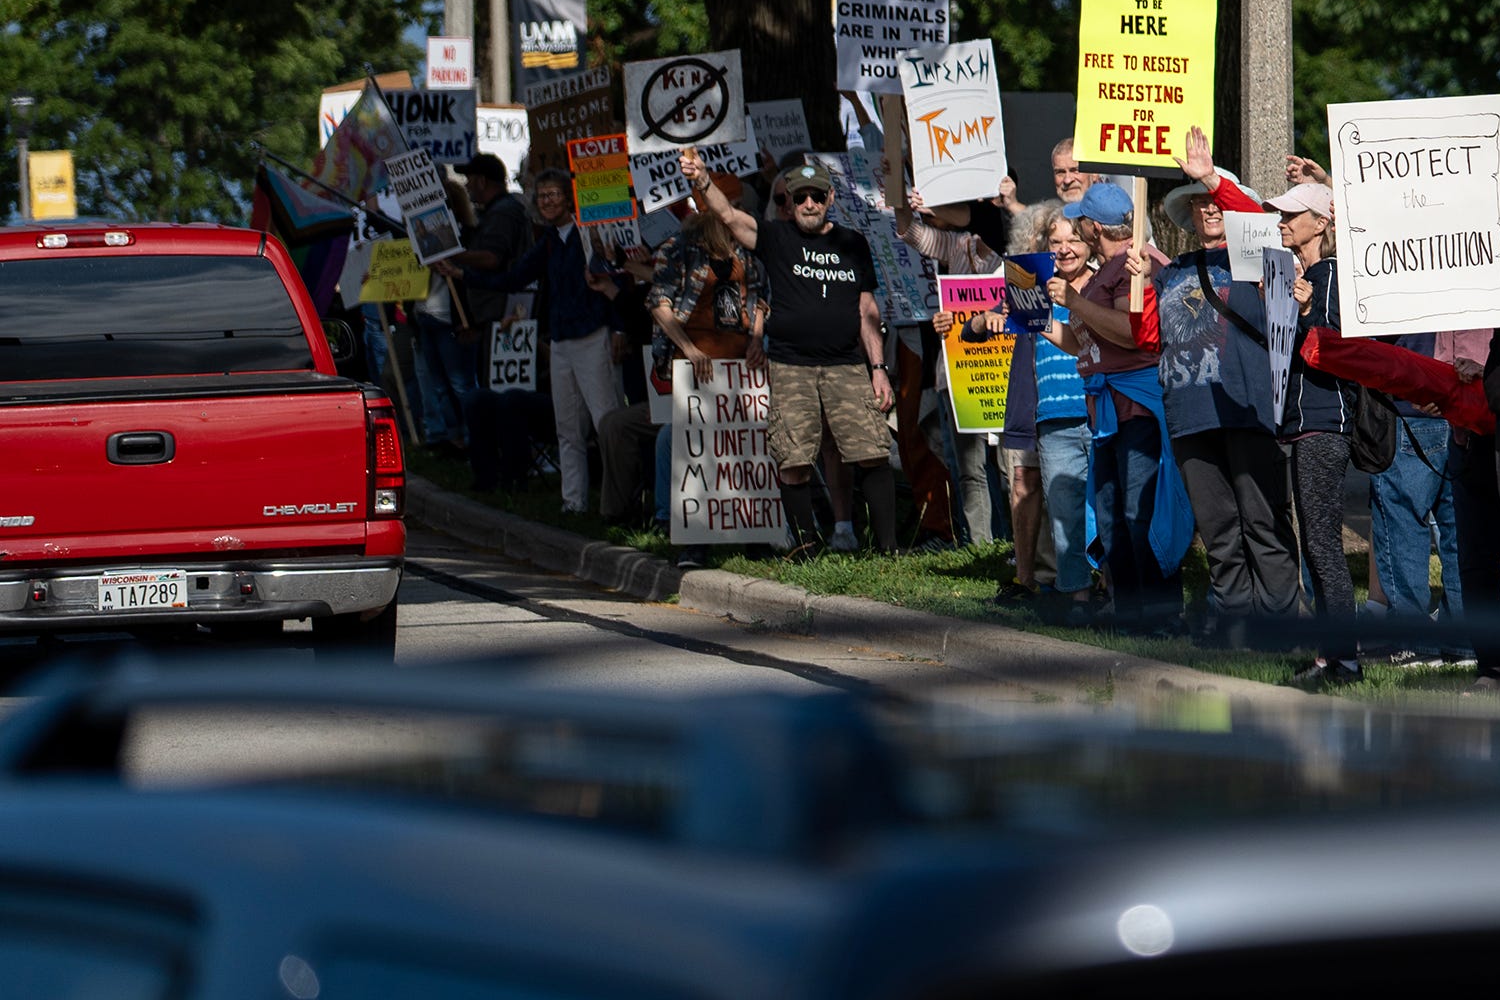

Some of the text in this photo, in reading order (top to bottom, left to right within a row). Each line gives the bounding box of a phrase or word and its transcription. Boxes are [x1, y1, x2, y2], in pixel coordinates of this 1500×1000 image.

[838, 2, 946, 24] CRIMINALS
[1135, 0, 1162, 10] TO BE
[520, 20, 577, 42] UWM
[838, 25, 945, 43] ARE IN THE
[1120, 15, 1167, 36] HERE
[443, 46, 456, 60] NO
[861, 45, 900, 59] WHI
[861, 63, 899, 78] HOU
[905, 48, 990, 88] IMPEACH
[1084, 53, 1189, 73] FREE TO RESIST
[431, 67, 468, 84] PARKING
[527, 67, 608, 106] IMMIGRANTS
[1098, 83, 1183, 104] RESISTING
[387, 92, 456, 125] HONK
[537, 96, 609, 131] WELCOME
[1133, 109, 1154, 122] FOR
[575, 138, 619, 157] LOVE
[916, 108, 995, 166] TRUMP
[1100, 124, 1172, 155] FREE
[633, 149, 680, 169] Forwar
[1358, 146, 1481, 183] PROTECT
[649, 161, 681, 181] NO
[649, 177, 692, 202] STE
[1402, 188, 1444, 209] the
[1365, 231, 1493, 277] CONSTITUTION
[793, 263, 855, 283] screwed
[949, 288, 1006, 302] I WILL VO
[1009, 287, 1050, 311] NOPE
[952, 311, 966, 324] TO
[964, 344, 1014, 354] WOMEN'S RIG
[492, 359, 530, 384] ICE
[956, 358, 1002, 368] AFFORDABLE
[971, 372, 999, 382] LGBTQ+
[688, 394, 770, 424] R RAPIS
[980, 399, 994, 407] THE
[686, 429, 771, 457] U UNFIT
[681, 461, 781, 492] M MORON
[263, 502, 358, 516] CHEVROLET
[683, 498, 782, 530] P PERVERT
[102, 575, 148, 585] WISCONSIN
[104, 583, 178, 607] A TA7289
